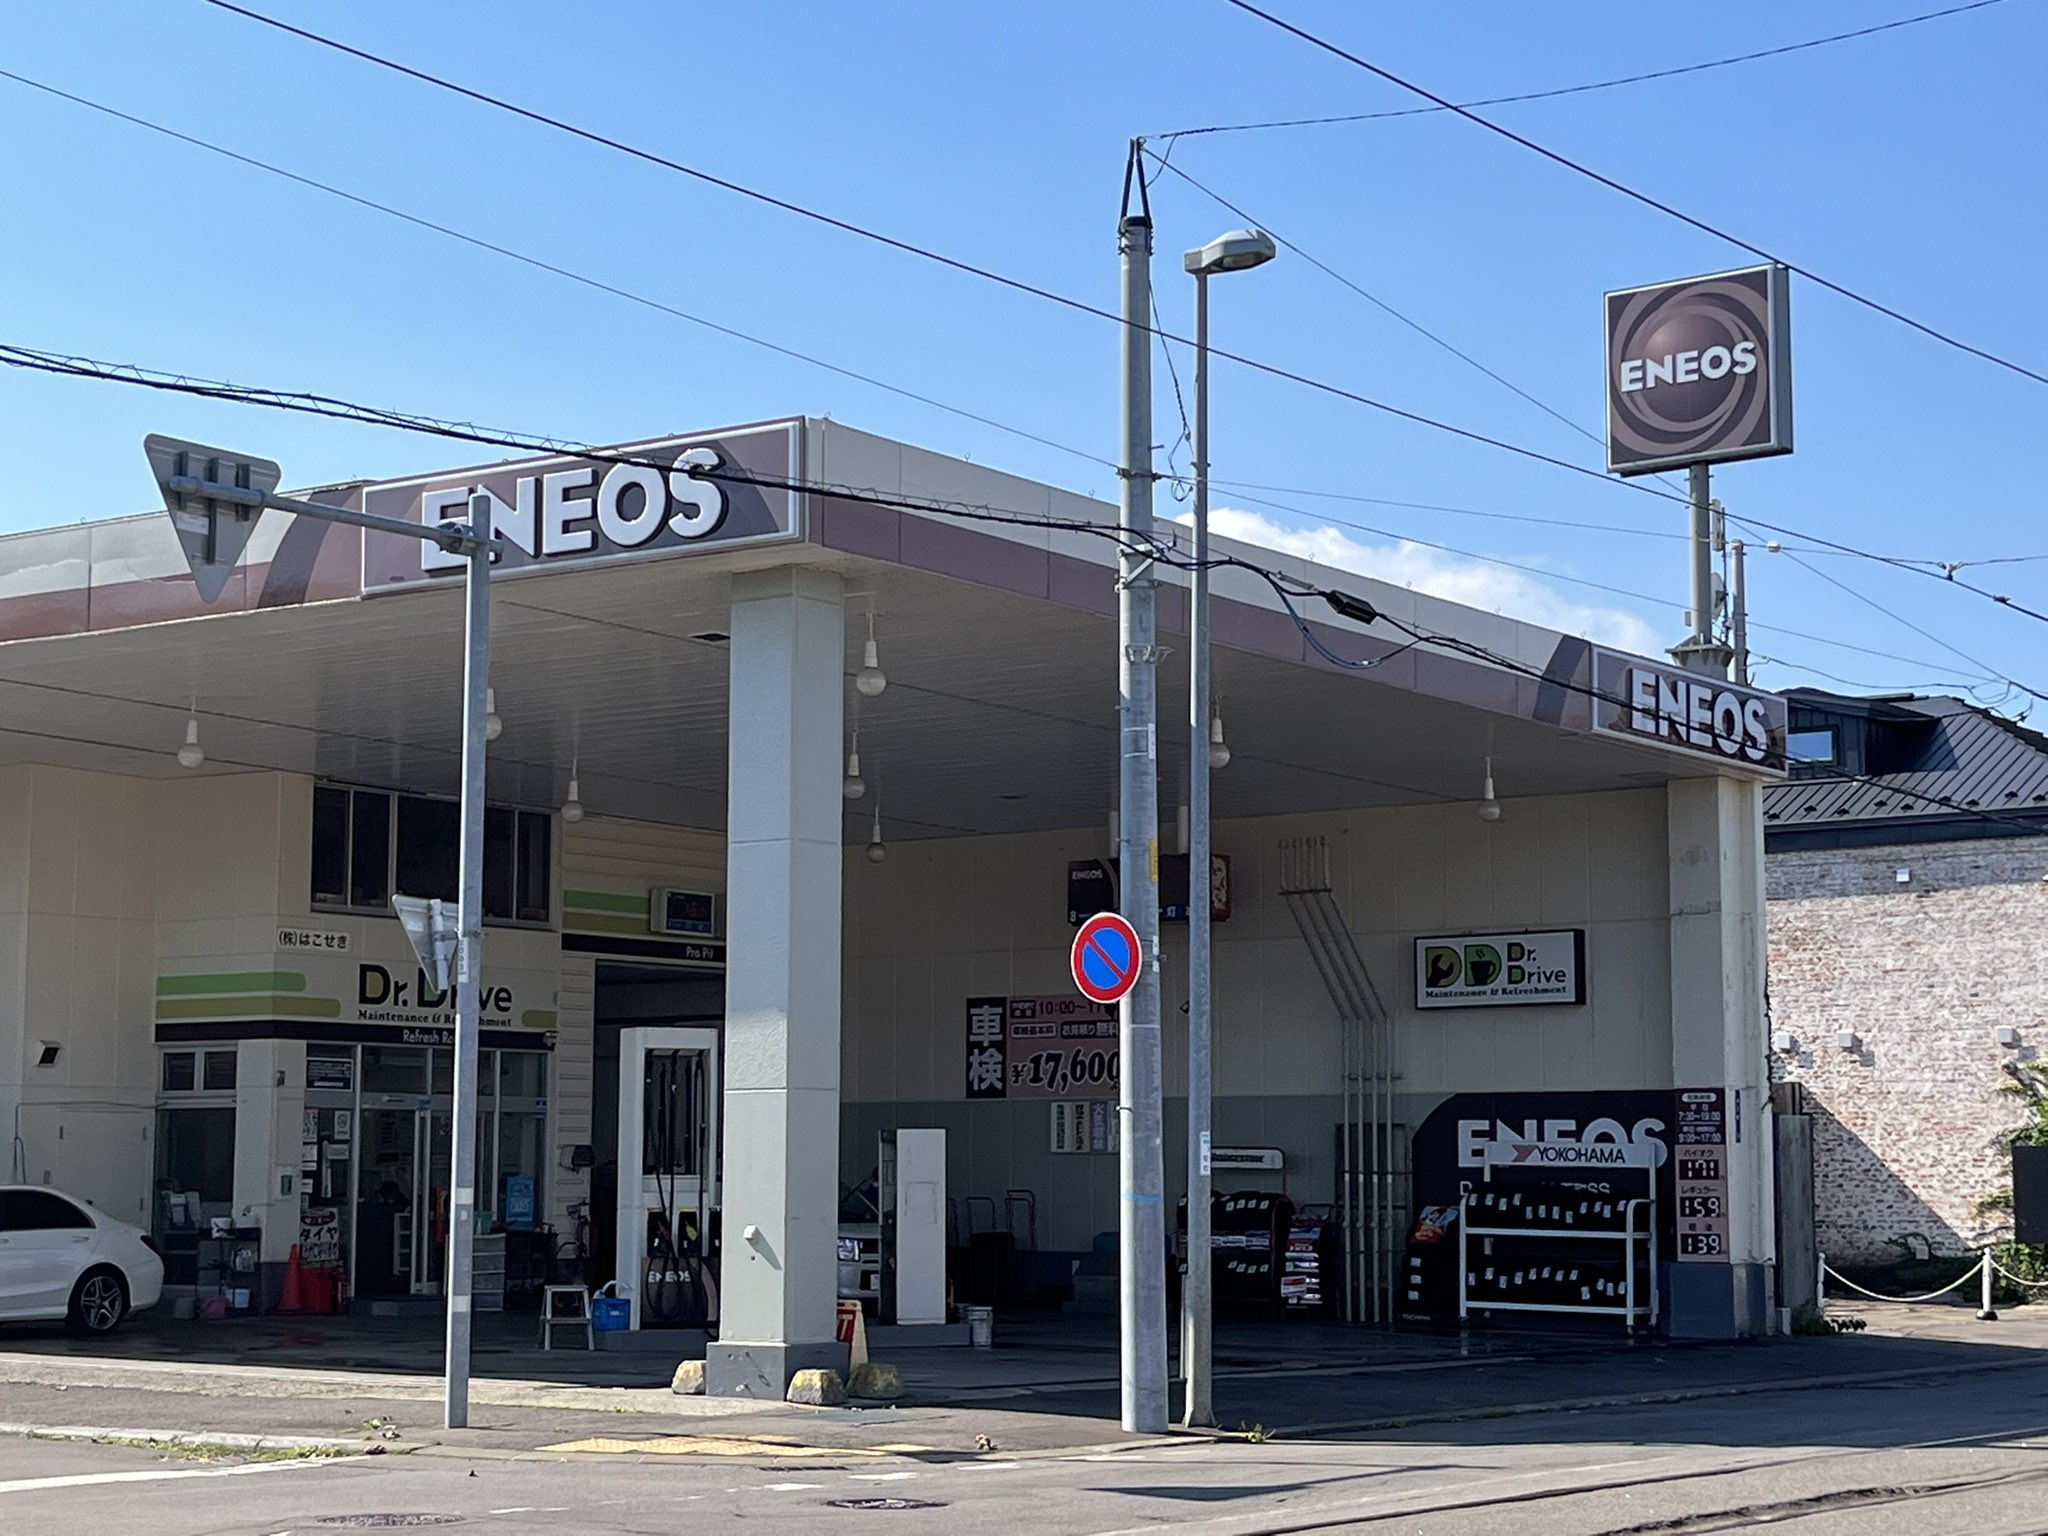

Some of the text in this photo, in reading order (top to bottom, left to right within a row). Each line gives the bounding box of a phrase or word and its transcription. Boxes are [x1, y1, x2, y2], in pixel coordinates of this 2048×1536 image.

[1620, 341, 1757, 392] ENEOS
[422, 447, 723, 569] ENEOS
[1632, 668, 1767, 760] ENEOS
[1507, 942, 1536, 962] Dr.
[1507, 965, 1567, 985] Drive
[359, 964, 512, 1012] Dr. Dve
[1425, 989, 1488, 999] Maintenance
[1501, 986, 1567, 997] Refreshment
[358, 1009, 429, 1023] Maintenance
[403, 1028, 440, 1044] Refresh
[969, 1003, 1005, 1091] 車検
[1537, 1147, 1626, 1163] YOKOHAMA
[1687, 1160, 1715, 1178] 171
[1685, 1198, 1719, 1217] 159
[1687, 1235, 1720, 1254] 139
